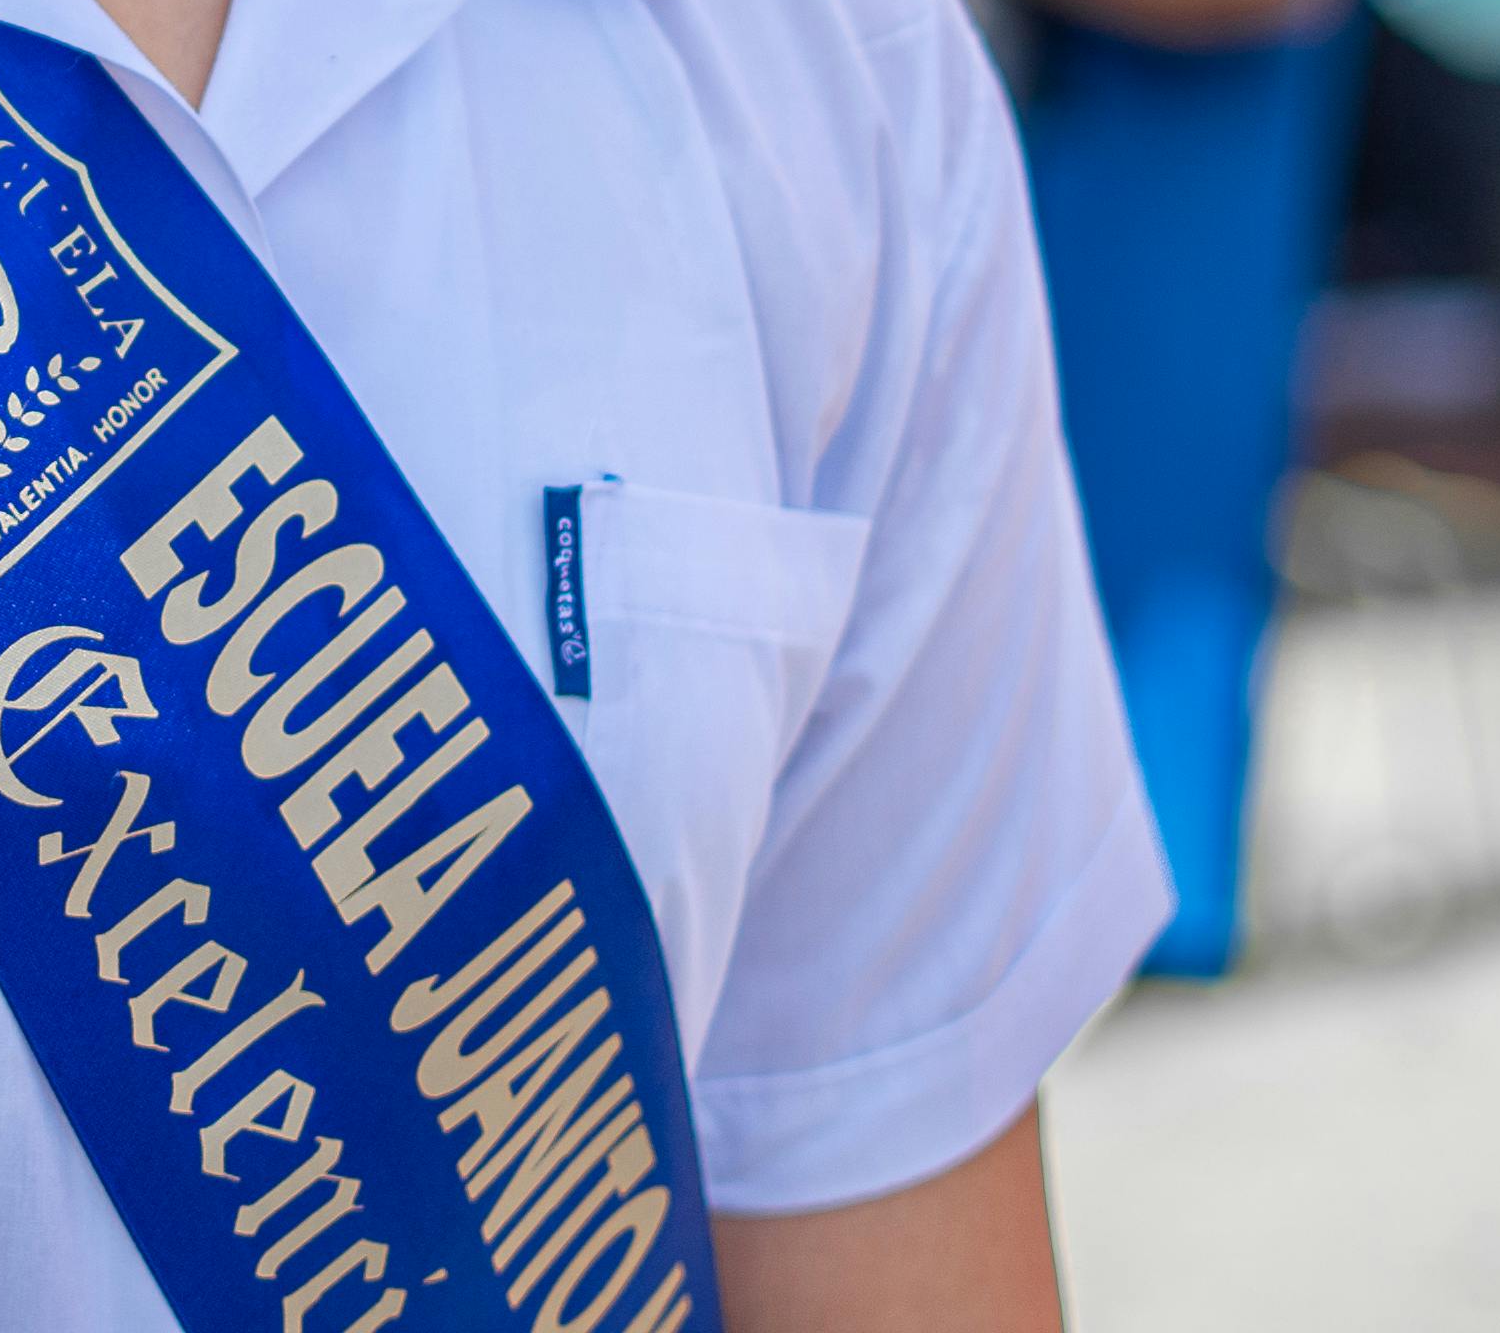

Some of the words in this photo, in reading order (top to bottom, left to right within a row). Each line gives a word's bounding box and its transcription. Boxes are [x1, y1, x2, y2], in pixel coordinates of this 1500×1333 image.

[94, 368, 167, 442] HONOR
[120, 416, 532, 975] ESCUELA
[392, 880, 669, 1333] JUANITO
